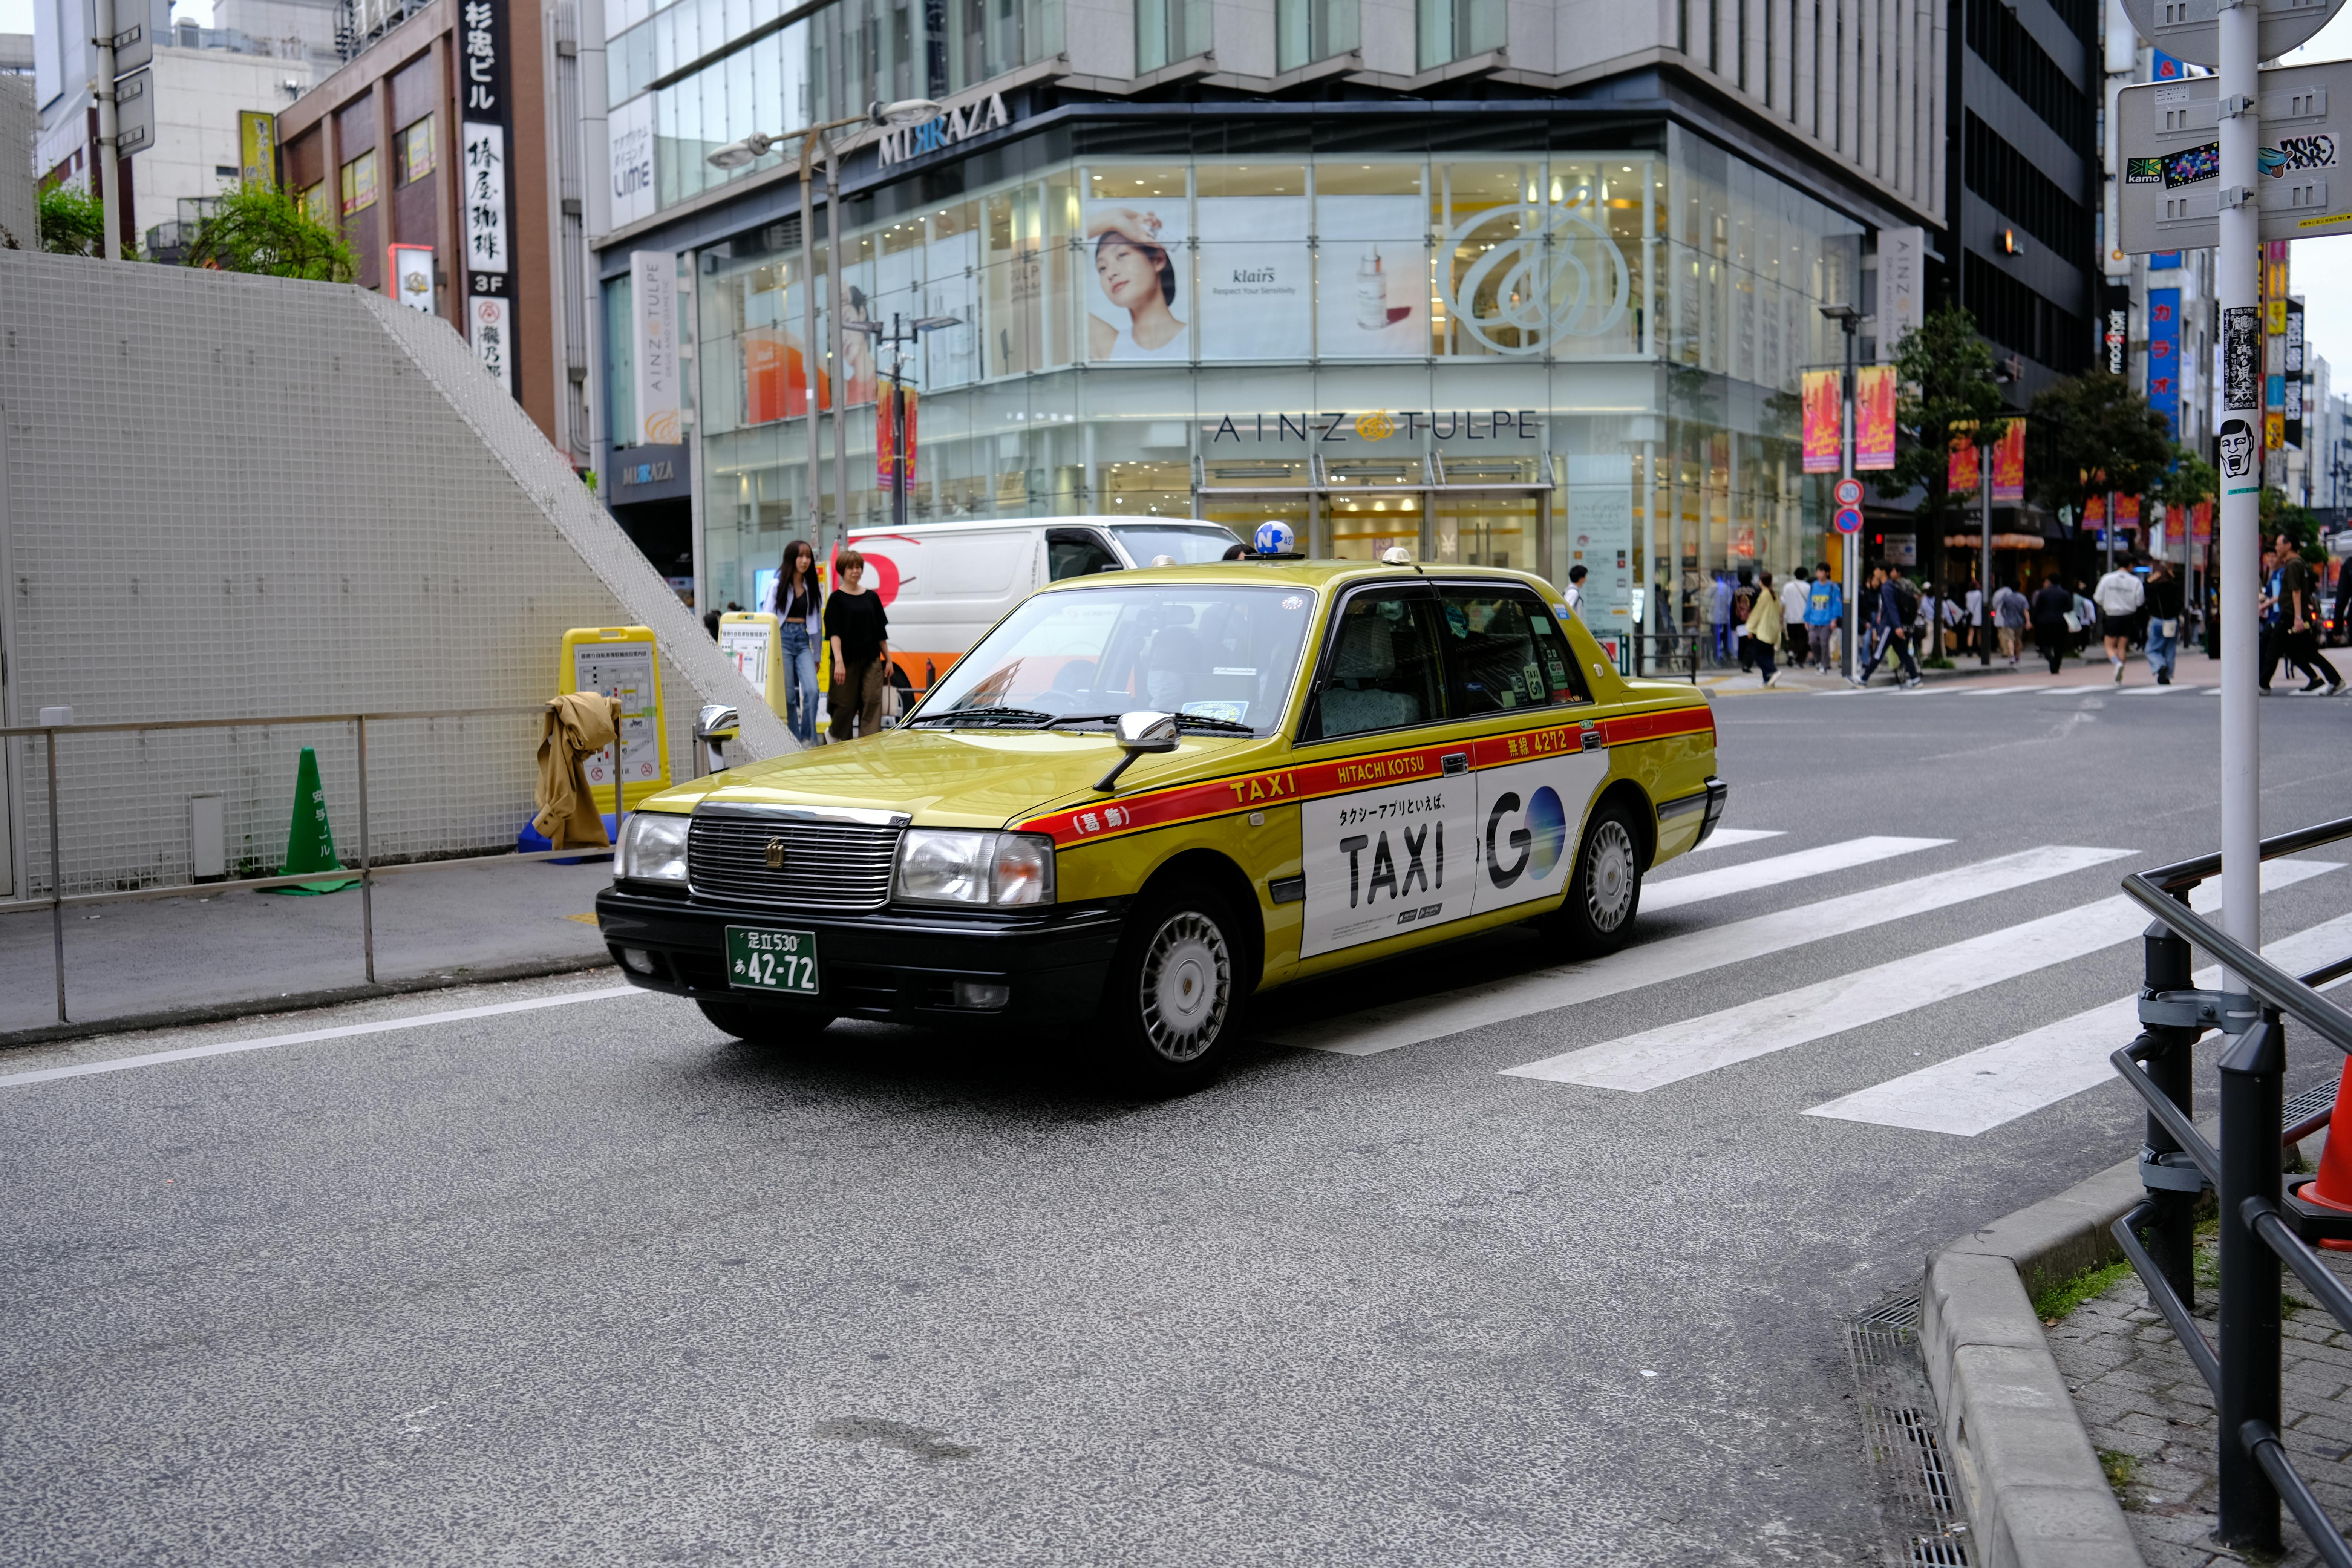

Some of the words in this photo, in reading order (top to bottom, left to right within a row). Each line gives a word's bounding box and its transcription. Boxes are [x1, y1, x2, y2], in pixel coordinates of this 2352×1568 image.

[464, 1, 495, 110] 杉忠ビル
[468, 136, 501, 259] 椿屋珈琲
[1233, 269, 1275, 283] klairs
[1897, 240, 1910, 294] AINZ
[475, 275, 503, 292] 3F
[1213, 288, 1242, 297] Respect
[1260, 286, 1296, 295] Sensitivity
[1213, 413, 1348, 442] AINZ
[1399, 410, 1537, 440] TULPE
[1842, 485, 1857, 499] 30
[1257, 531, 1272, 548] N
[1526, 670, 1539, 679] TAXI
[1508, 737, 1530, 757] 無線
[1535, 729, 1568, 753] 4272
[1337, 760, 1386, 784] HITACHI
[1387, 755, 1424, 775] KOTSU
[1229, 773, 1296, 803] TAXI
[1339, 793, 1446, 826] タクシーアプリといえば、
[1340, 820, 1444, 909] TAXI
[734, 959, 746, 974] あ
[748, 952, 815, 989] 42-72
